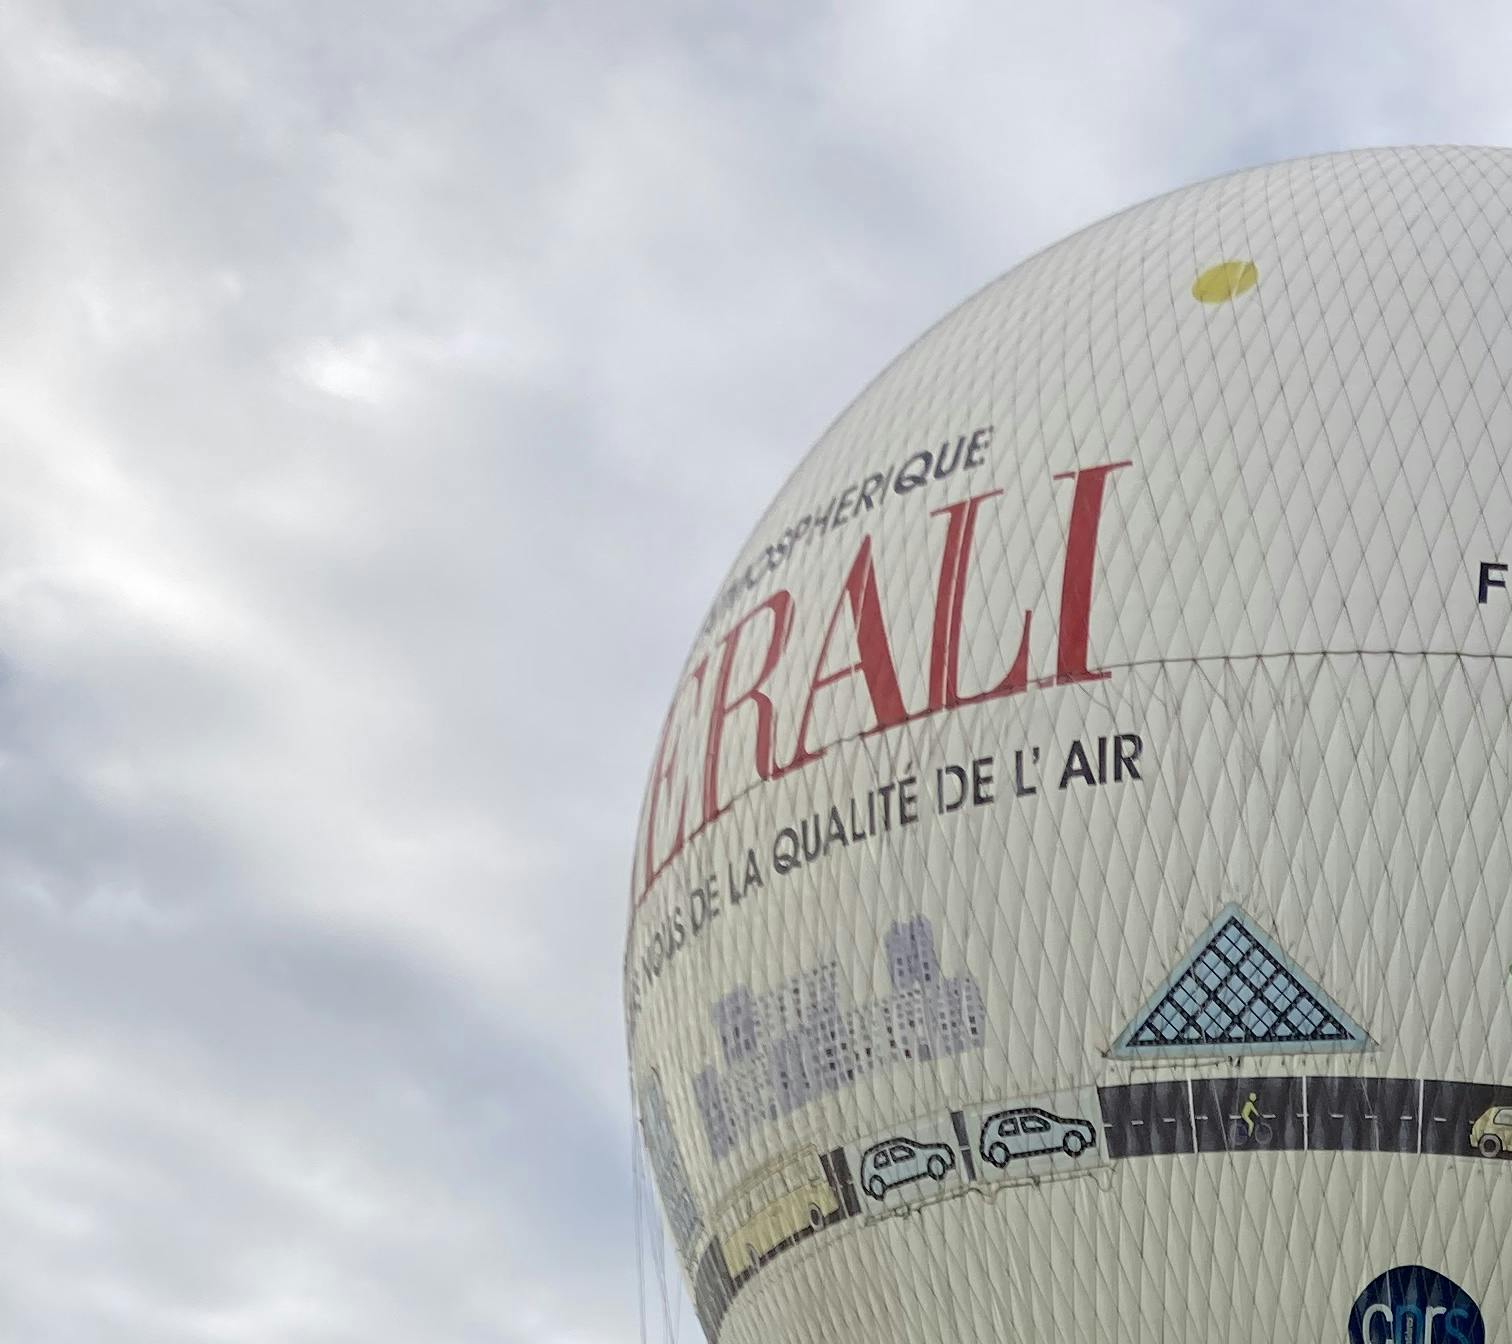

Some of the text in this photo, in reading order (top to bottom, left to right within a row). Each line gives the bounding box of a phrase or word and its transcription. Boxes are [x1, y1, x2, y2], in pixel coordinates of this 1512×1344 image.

[689, 875, 720, 938] DE
[728, 848, 764, 905] LA
[772, 762, 919, 876] QUALITÉ
[937, 756, 994, 816] DE
